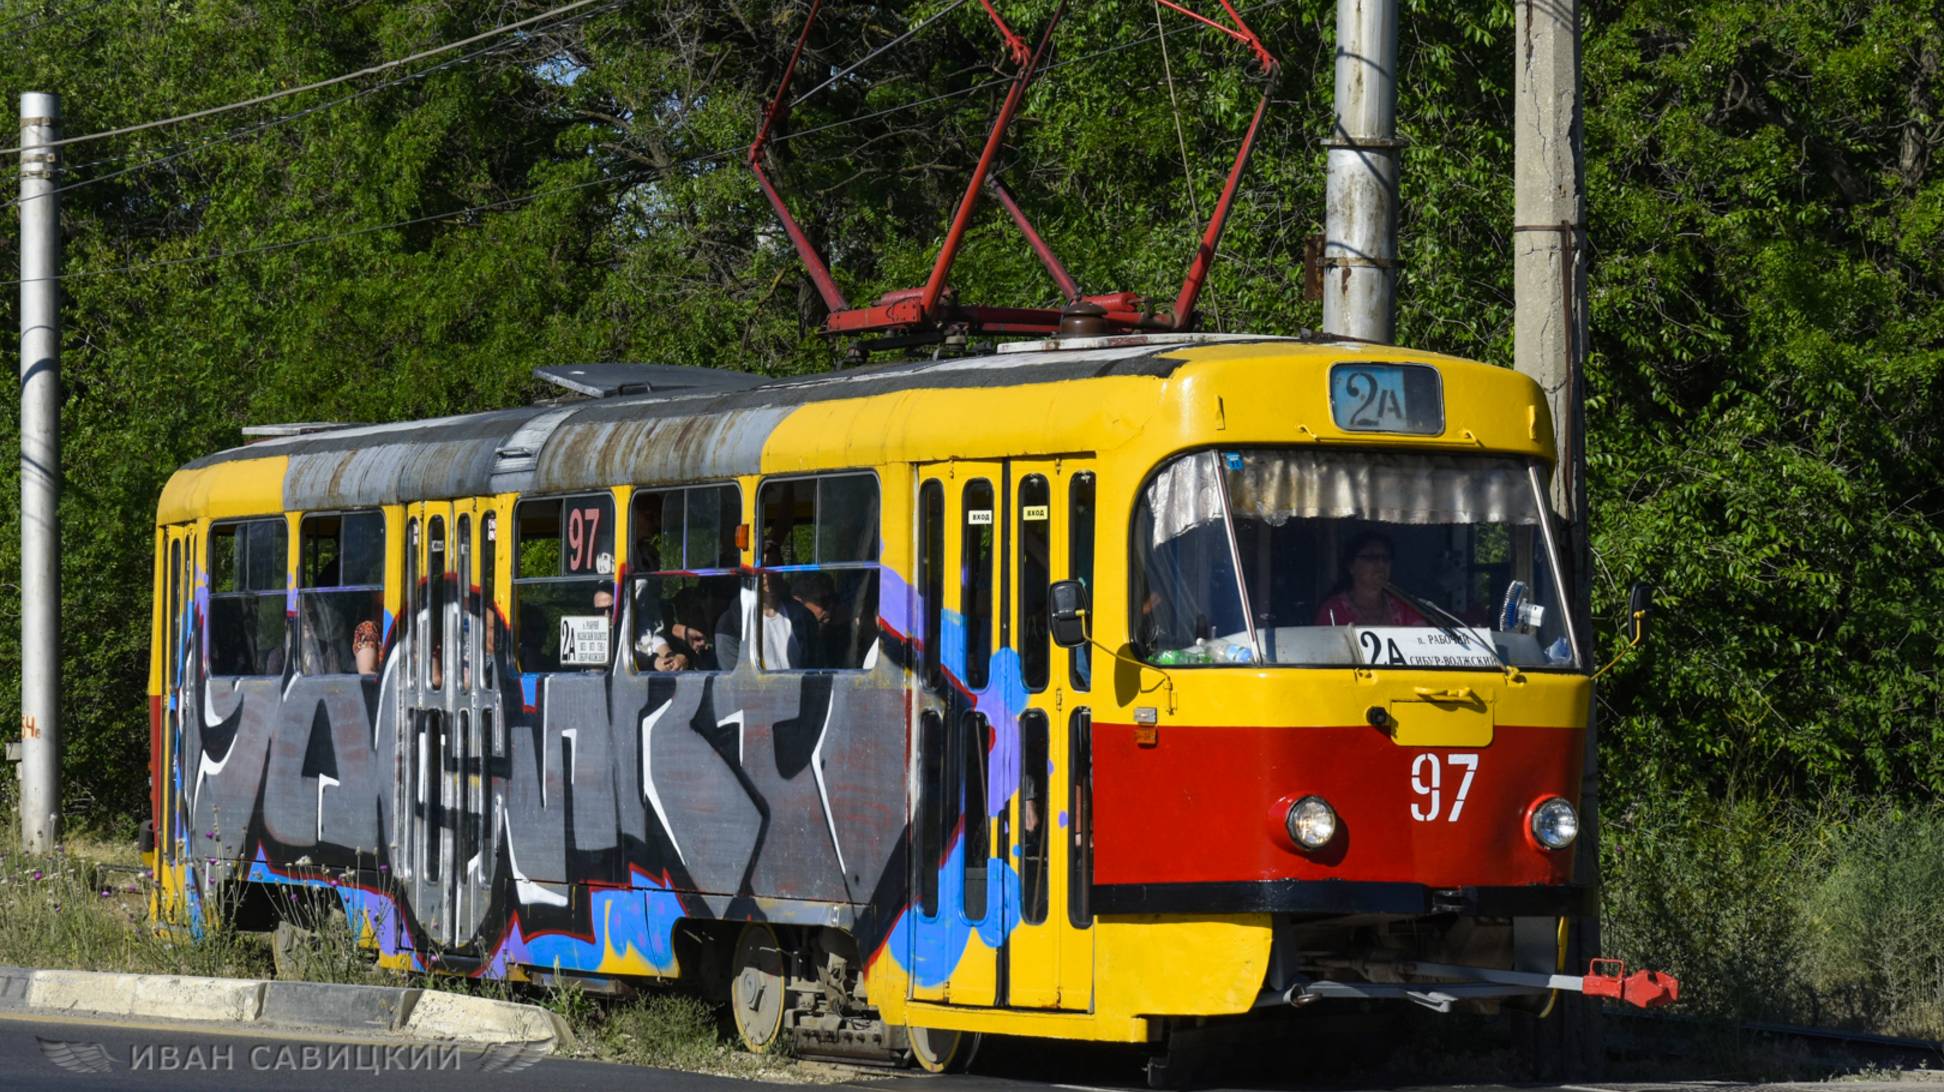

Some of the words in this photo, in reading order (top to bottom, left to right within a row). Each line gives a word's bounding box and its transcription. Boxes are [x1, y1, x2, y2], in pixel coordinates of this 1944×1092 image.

[1346, 372, 1404, 426] 2А
[972, 513, 990, 522] ВХОД
[1026, 509, 1045, 517] ВХОД
[568, 507, 600, 571] 97
[561, 620, 576, 661] 2А
[1360, 630, 1407, 665] 2А
[1410, 753, 1479, 823] 97
